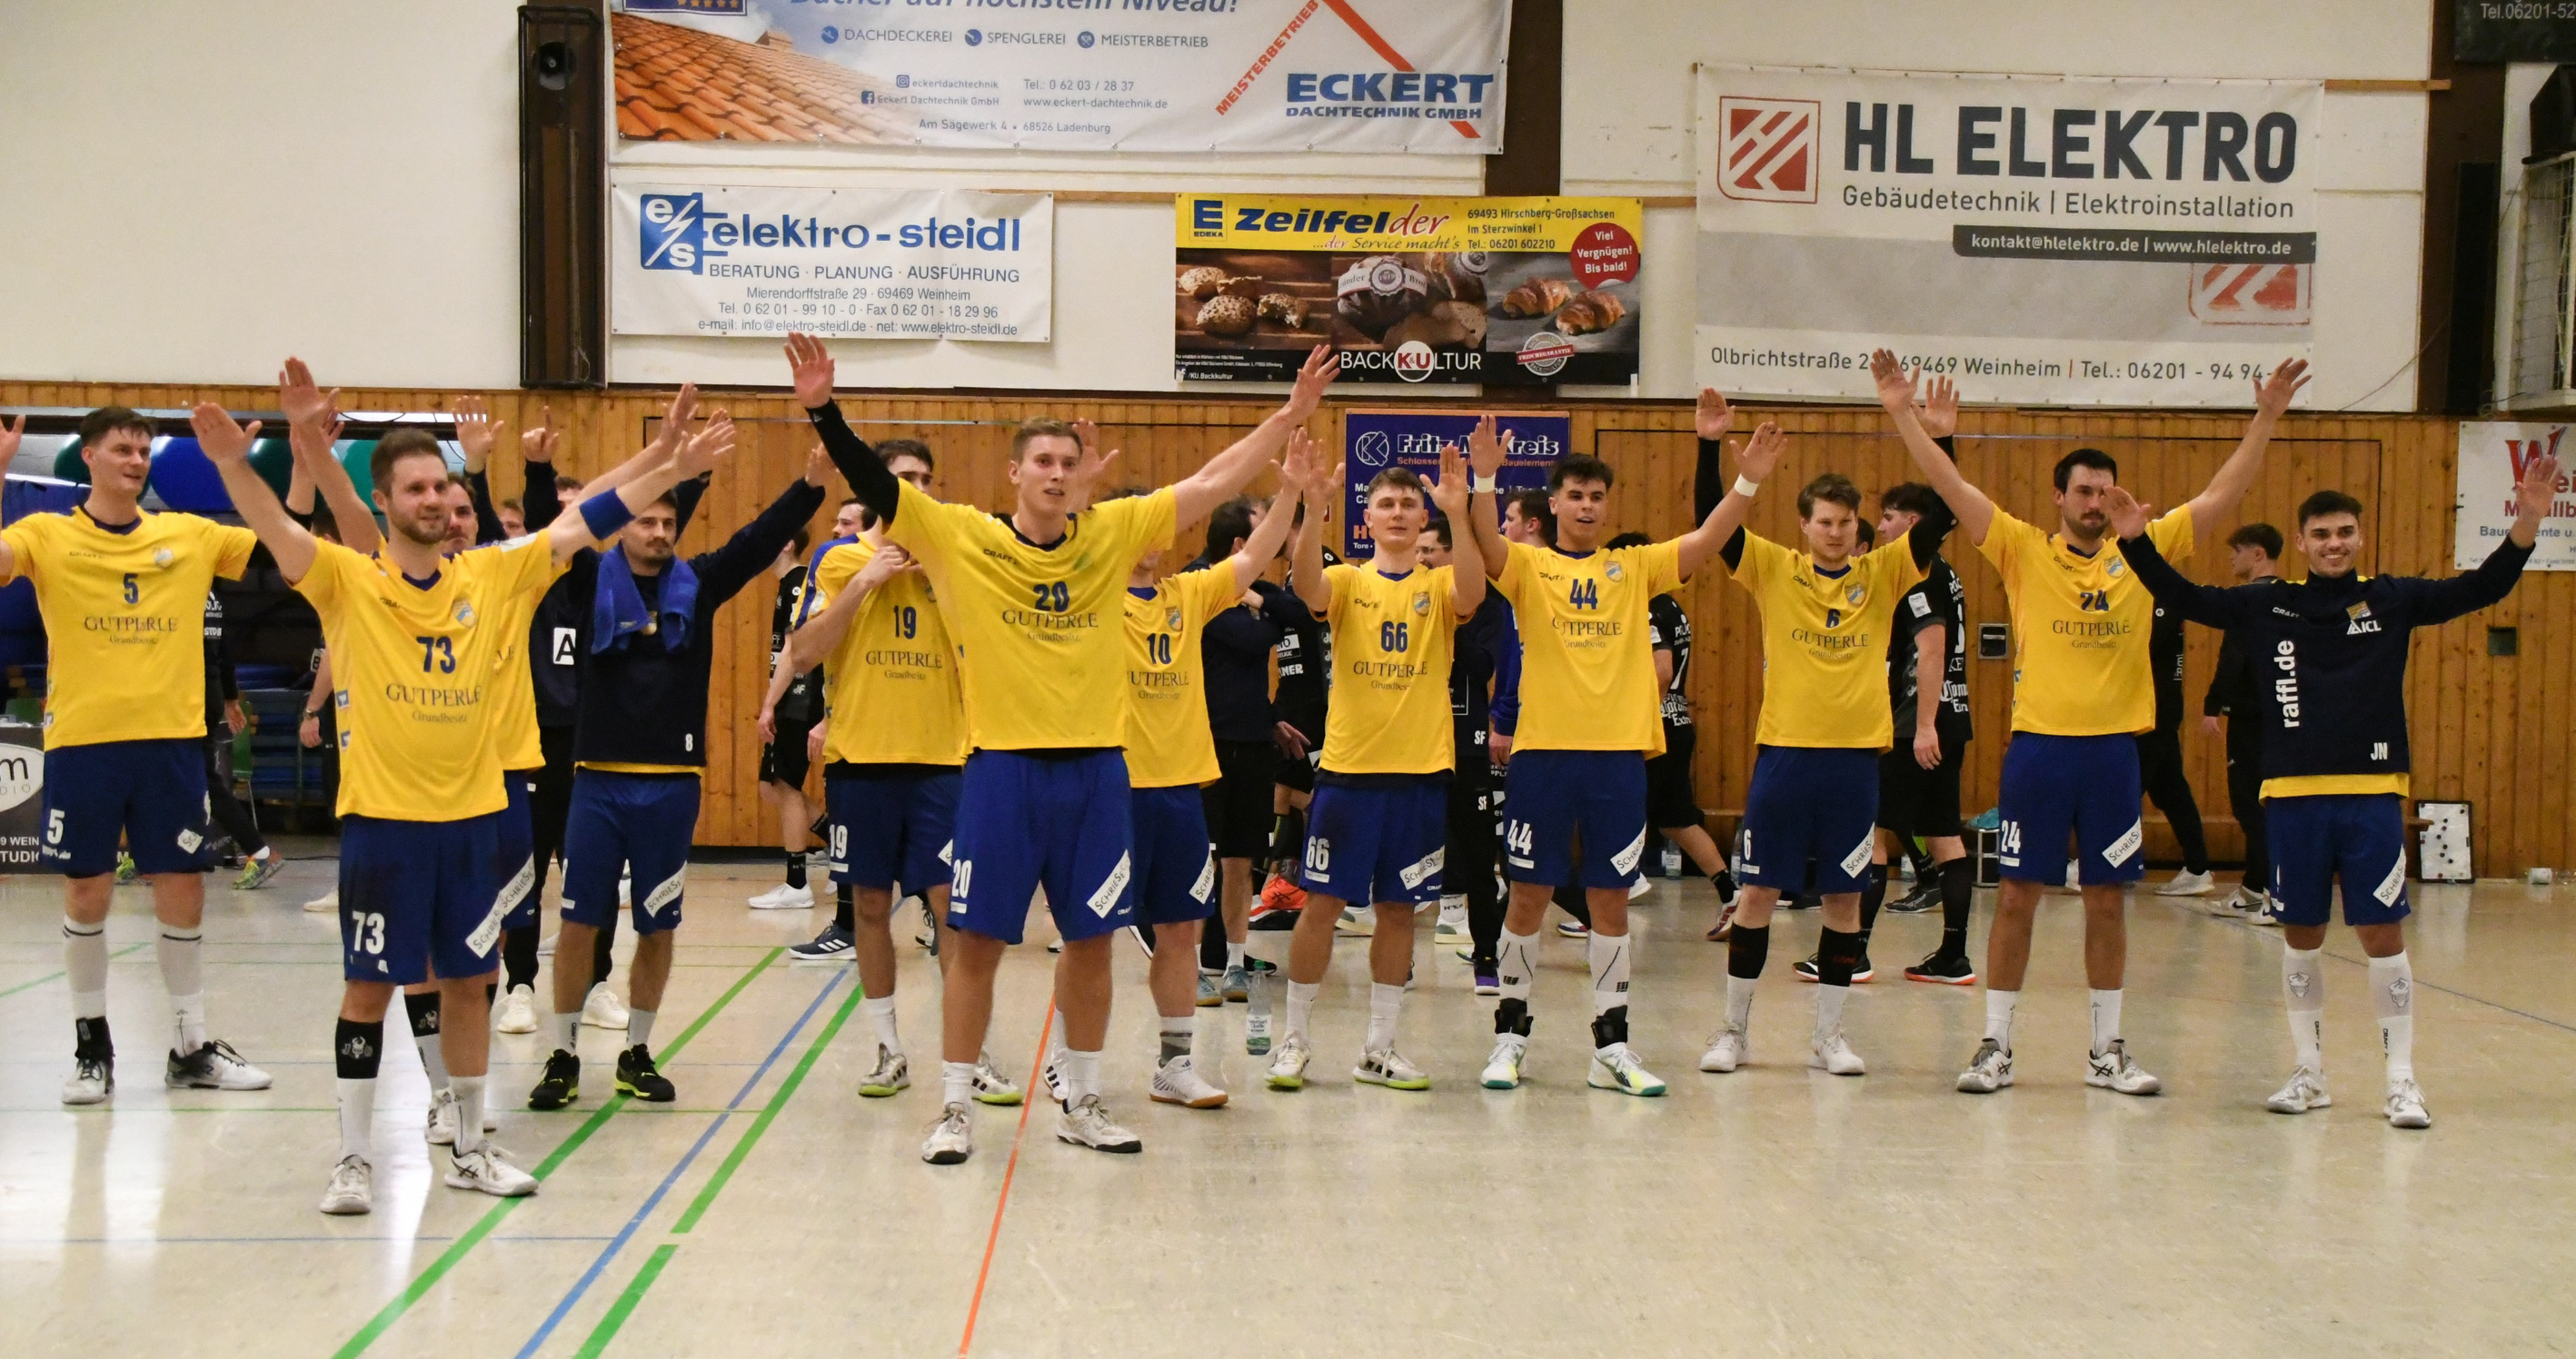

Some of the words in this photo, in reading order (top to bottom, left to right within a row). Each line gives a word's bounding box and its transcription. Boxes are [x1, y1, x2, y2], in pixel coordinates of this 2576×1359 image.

[844, 29, 952, 43] DACHDECKEREI
[988, 32, 1066, 45] SPENGLEREI
[1101, 34, 1208, 47] MEISTERBETRIEB
[1216, 0, 1319, 115] MEISTERBETRIEB
[911, 79, 999, 89] eckertdachtechnik
[1024, 78, 1045, 91] Tel.:
[1049, 79, 1057, 91] 0
[1059, 79, 1073, 91] 62
[1078, 80, 1091, 91] 03
[1104, 80, 1118, 92] 28
[1121, 80, 1135, 92] 37
[1287, 73, 1494, 104] ECKERT
[877, 95, 908, 104] Eckert
[910, 95, 969, 105] Dachtechnik
[970, 96, 1000, 106] GmbH
[1023, 97, 1169, 109] www.eckert-dachtechnik.de
[1286, 106, 1420, 118] DACHTECHNIK
[1425, 107, 1482, 120] GMBH
[919, 119, 939, 130] Am
[941, 118, 998, 132] Sägewerk
[1001, 120, 1008, 130] 4
[1023, 121, 1054, 133] 68526
[1057, 123, 1111, 135] Ladenburg
[1844, 101, 1934, 174] HL
[1956, 105, 2297, 184] ELEKTRO
[1843, 184, 2041, 213] Gebäudetechnik
[2064, 192, 2294, 218] Elektroinstallation
[1193, 199, 1223, 229] E
[1467, 209, 1497, 219] 69493
[1501, 208, 1615, 220] Hirschberg-Großsachsen
[1467, 224, 1479, 233] Im
[1482, 223, 1537, 234] Sterzwinkel
[1595, 231, 1614, 241] Viel
[1352, 237, 1401, 249] Service
[1406, 235, 1459, 249] macht's
[1467, 240, 1487, 249] Tel.:
[1489, 239, 1518, 249] 06201
[1521, 240, 1556, 249] 602210
[1576, 244, 1633, 260] Vergnügen!
[1971, 233, 2140, 253] kontakt@hlelektro.de
[2153, 240, 2292, 255] www.hlelektro.de
[710, 264, 800, 279] BERATUNG
[815, 265, 893, 280] PLANUNG
[907, 263, 1019, 283] AUSFÜHRUNG
[1585, 263, 1601, 273] Bis
[1603, 262, 1627, 272] bald!
[747, 287, 849, 300] Mierendorffstraße
[852, 288, 867, 299] 29
[877, 287, 914, 300] 69469
[918, 288, 970, 301] Weinheim
[719, 303, 738, 314] Tel.
[743, 303, 751, 314] 0
[755, 303, 770, 314] 62
[774, 303, 788, 315] 01
[802, 303, 817, 315] 99
[822, 303, 836, 315] 10
[849, 304, 856, 315] 0
[866, 304, 887, 315] Fax
[891, 304, 899, 316] 0
[902, 304, 917, 316] 62
[921, 305, 935, 316] 01
[949, 305, 961, 317] 18
[965, 306, 980, 318] 29
[983, 306, 999, 318] 96
[698, 320, 738, 331] e-mail:
[877, 322, 898, 332] net:
[901, 322, 1018, 335] www.elektro-steidl.de
[1711, 347, 1853, 370] Olbrichtstraße
[1964, 357, 2061, 376] Weinheim
[2081, 360, 2121, 379] Tel.:
[2128, 362, 2185, 380] 06201
[2210, 362, 2234, 381] 94
[123, 572, 139, 605] 5
[1033, 580, 1070, 612] 20
[1569, 578, 1598, 610] 44
[2080, 589, 2110, 612] 24
[85, 616, 178, 631] GUTPERLE
[893, 605, 917, 640] 19
[1001, 609, 1099, 629] GUTPERLE
[2053, 620, 2132, 637] GUTPERLE
[1380, 620, 1408, 653] 66
[1792, 628, 1869, 649] GUTPERLE
[416, 636, 456, 674] 73
[555, 633, 576, 662] A
[1147, 632, 1172, 665] 10
[865, 650, 943, 669] GUTPERLE
[1127, 670, 1190, 687] UTPERLE
[2273, 640, 2300, 728] raffl.de
[685, 732, 693, 752] 8
[1474, 729, 1487, 745] SF
[2370, 742, 2388, 760] JN
[1477, 795, 1487, 810] SF
[46, 808, 65, 845] 5
[829, 824, 848, 859] 19
[1507, 818, 1533, 856] 44
[1743, 828, 1752, 861] 6
[2001, 819, 2022, 855] 24
[1305, 835, 1330, 871] 66
[951, 858, 972, 899] 20
[352, 909, 385, 955] 73
